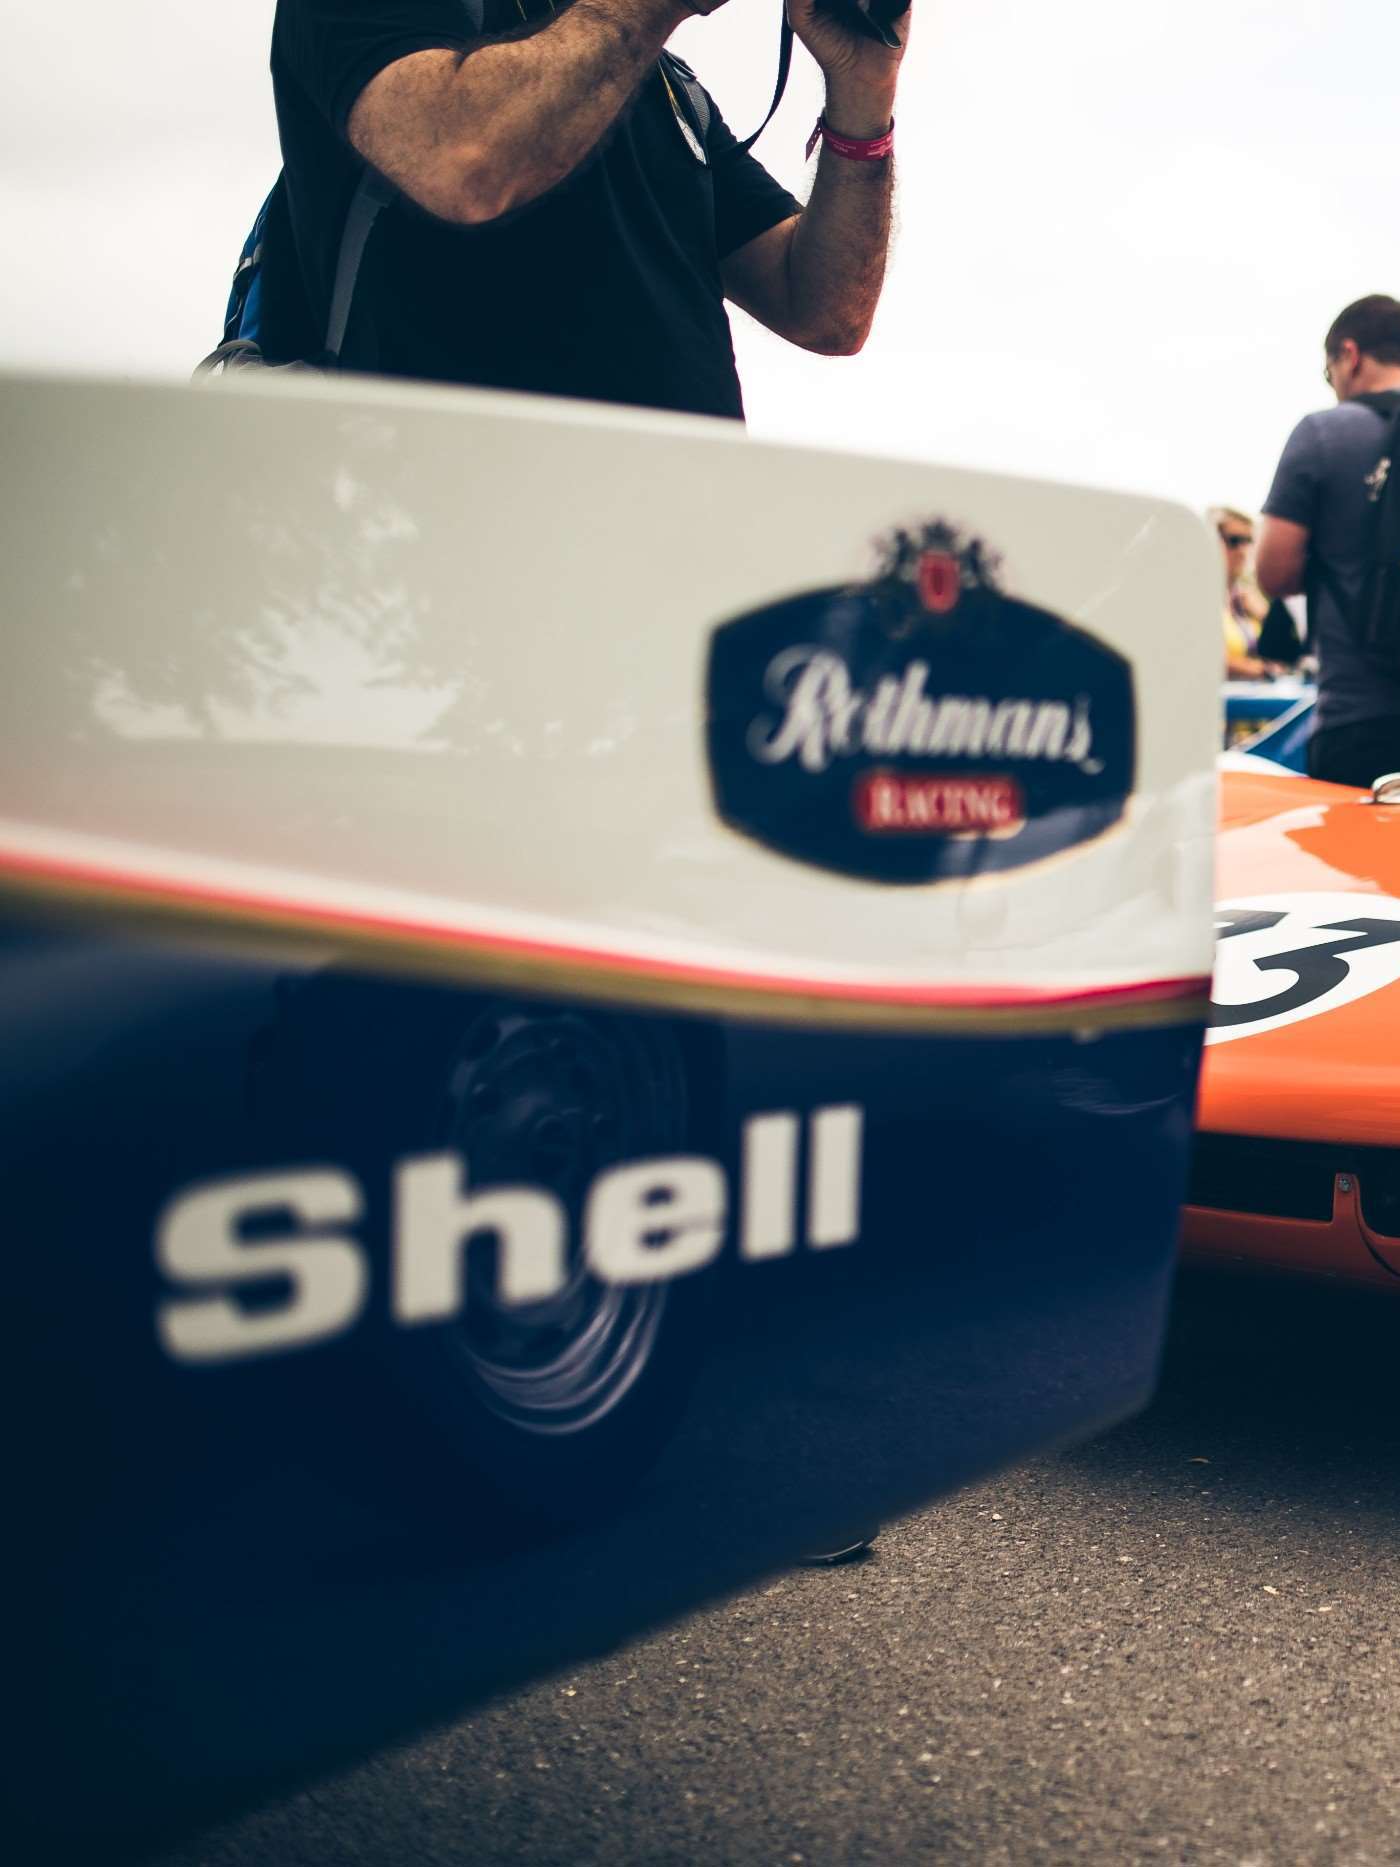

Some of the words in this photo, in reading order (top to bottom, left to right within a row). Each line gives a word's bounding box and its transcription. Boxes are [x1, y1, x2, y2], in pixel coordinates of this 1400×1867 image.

[747, 643, 1104, 773] Rothmans
[870, 779, 1012, 823] RACING
[157, 1103, 862, 1362] Shell
